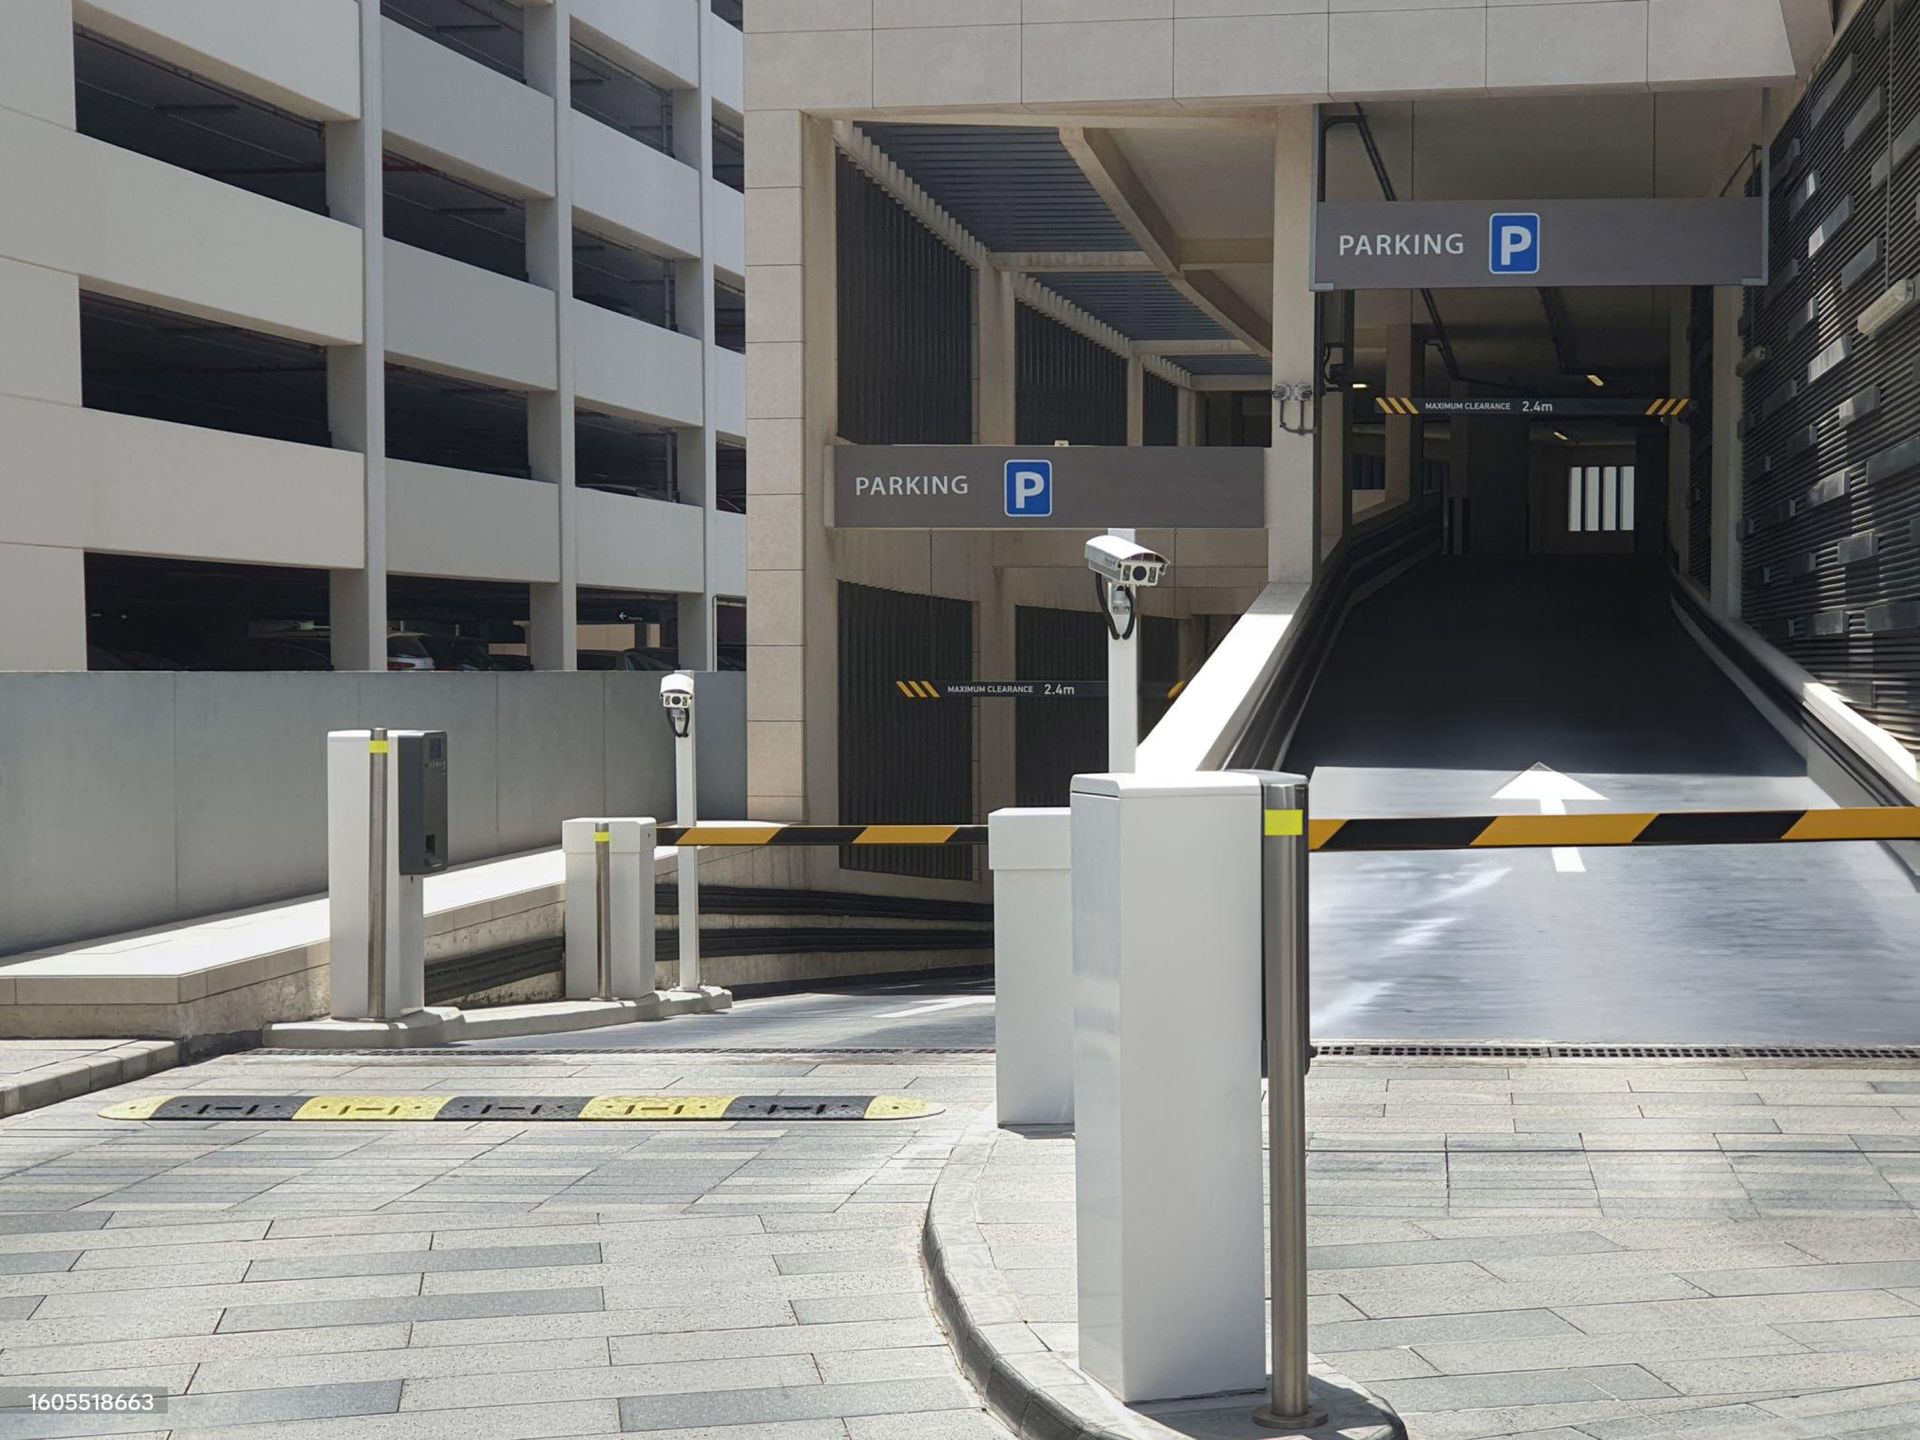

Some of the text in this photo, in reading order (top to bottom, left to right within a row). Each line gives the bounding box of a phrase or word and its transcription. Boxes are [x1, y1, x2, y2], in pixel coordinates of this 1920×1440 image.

[1339, 225, 1532, 266] PARKING P
[1425, 400, 1553, 412] MAXIMUM CLEARANCE 2.4m
[855, 471, 1045, 509] PARKING P
[947, 683, 1075, 695] MAXIMUM CLEARANCE 2.4m
